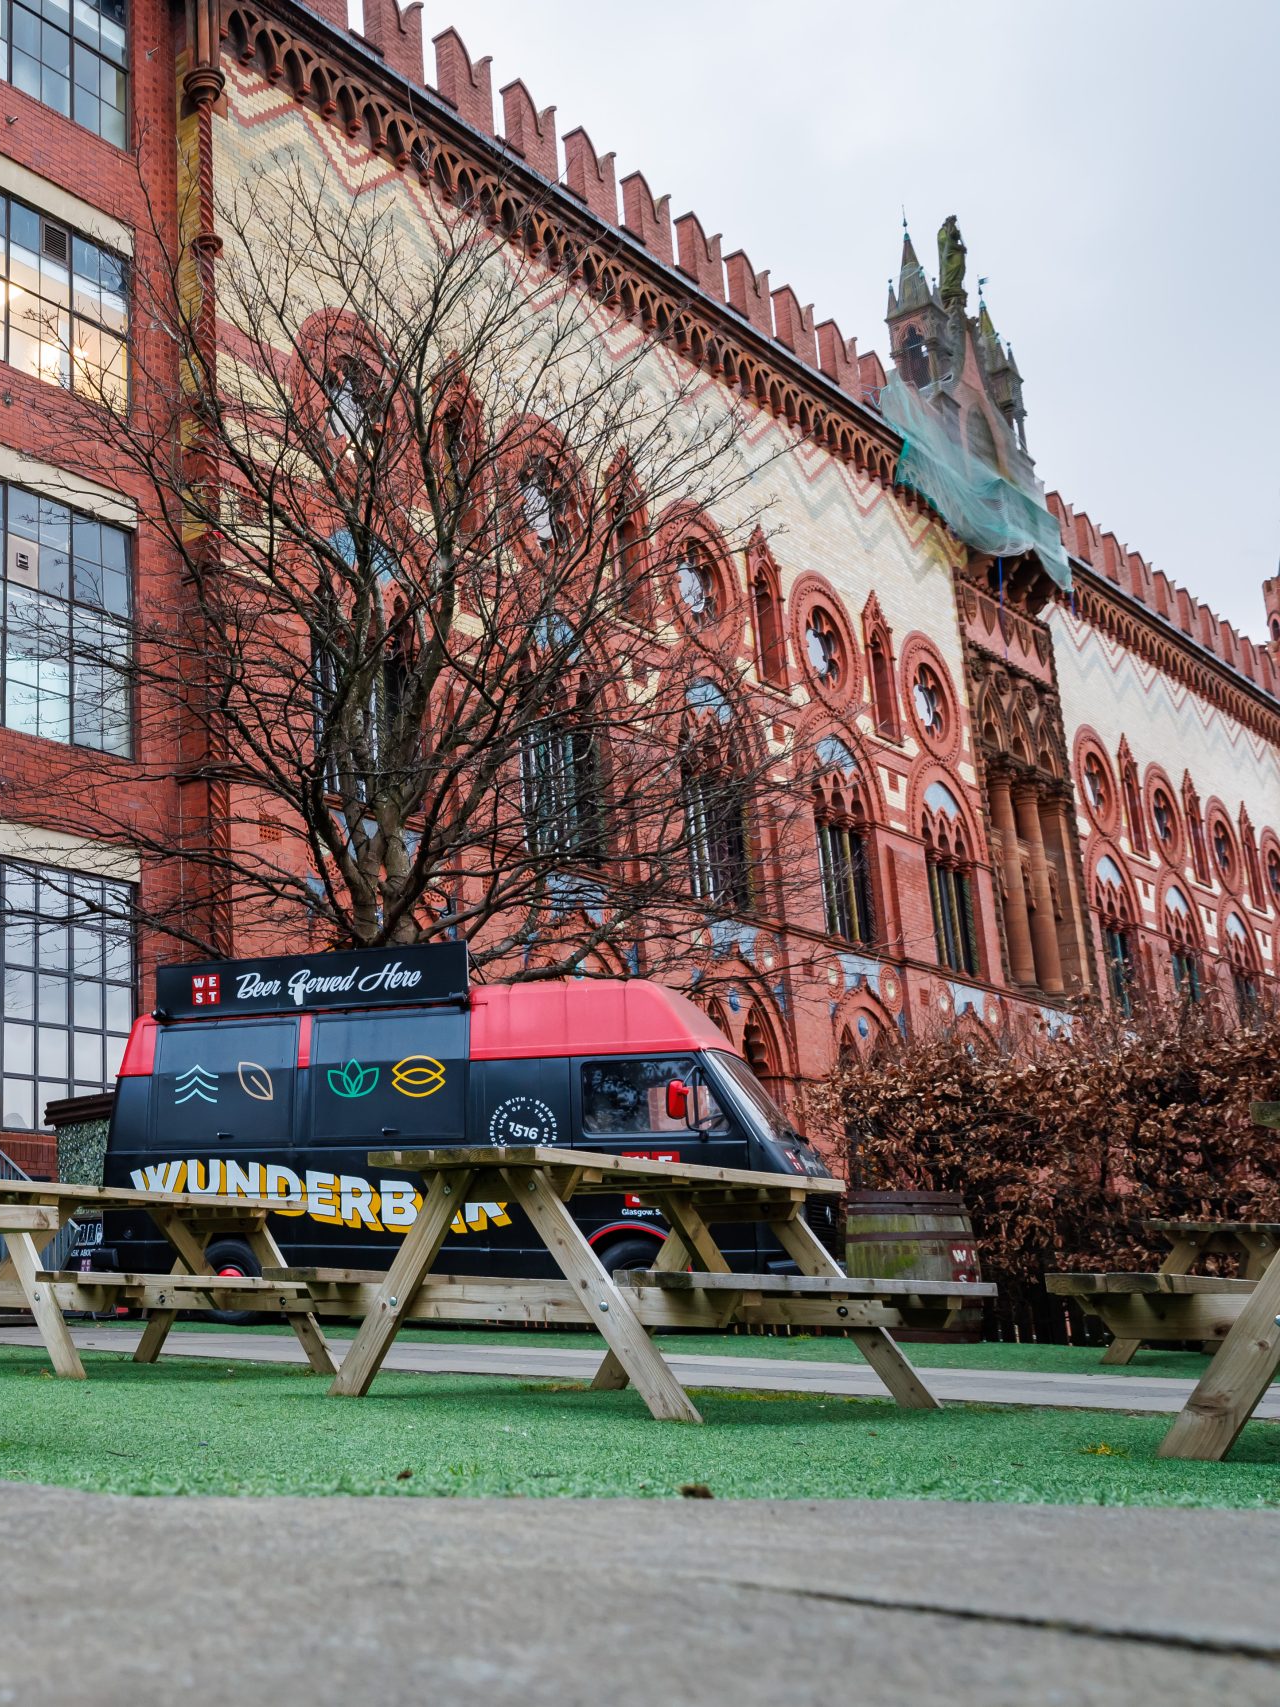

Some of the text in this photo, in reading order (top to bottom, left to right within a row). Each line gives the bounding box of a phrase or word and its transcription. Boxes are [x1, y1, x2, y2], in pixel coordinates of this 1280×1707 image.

[236, 961, 422, 1006] Beer Served Here
[505, 1096, 526, 1106] WITH
[498, 1113, 508, 1129] LAW
[534, 1109, 547, 1122] THE
[535, 1100, 557, 1128] BREWED
[508, 1121, 539, 1140] 1516
[130, 1159, 511, 1232] WUNDERB
